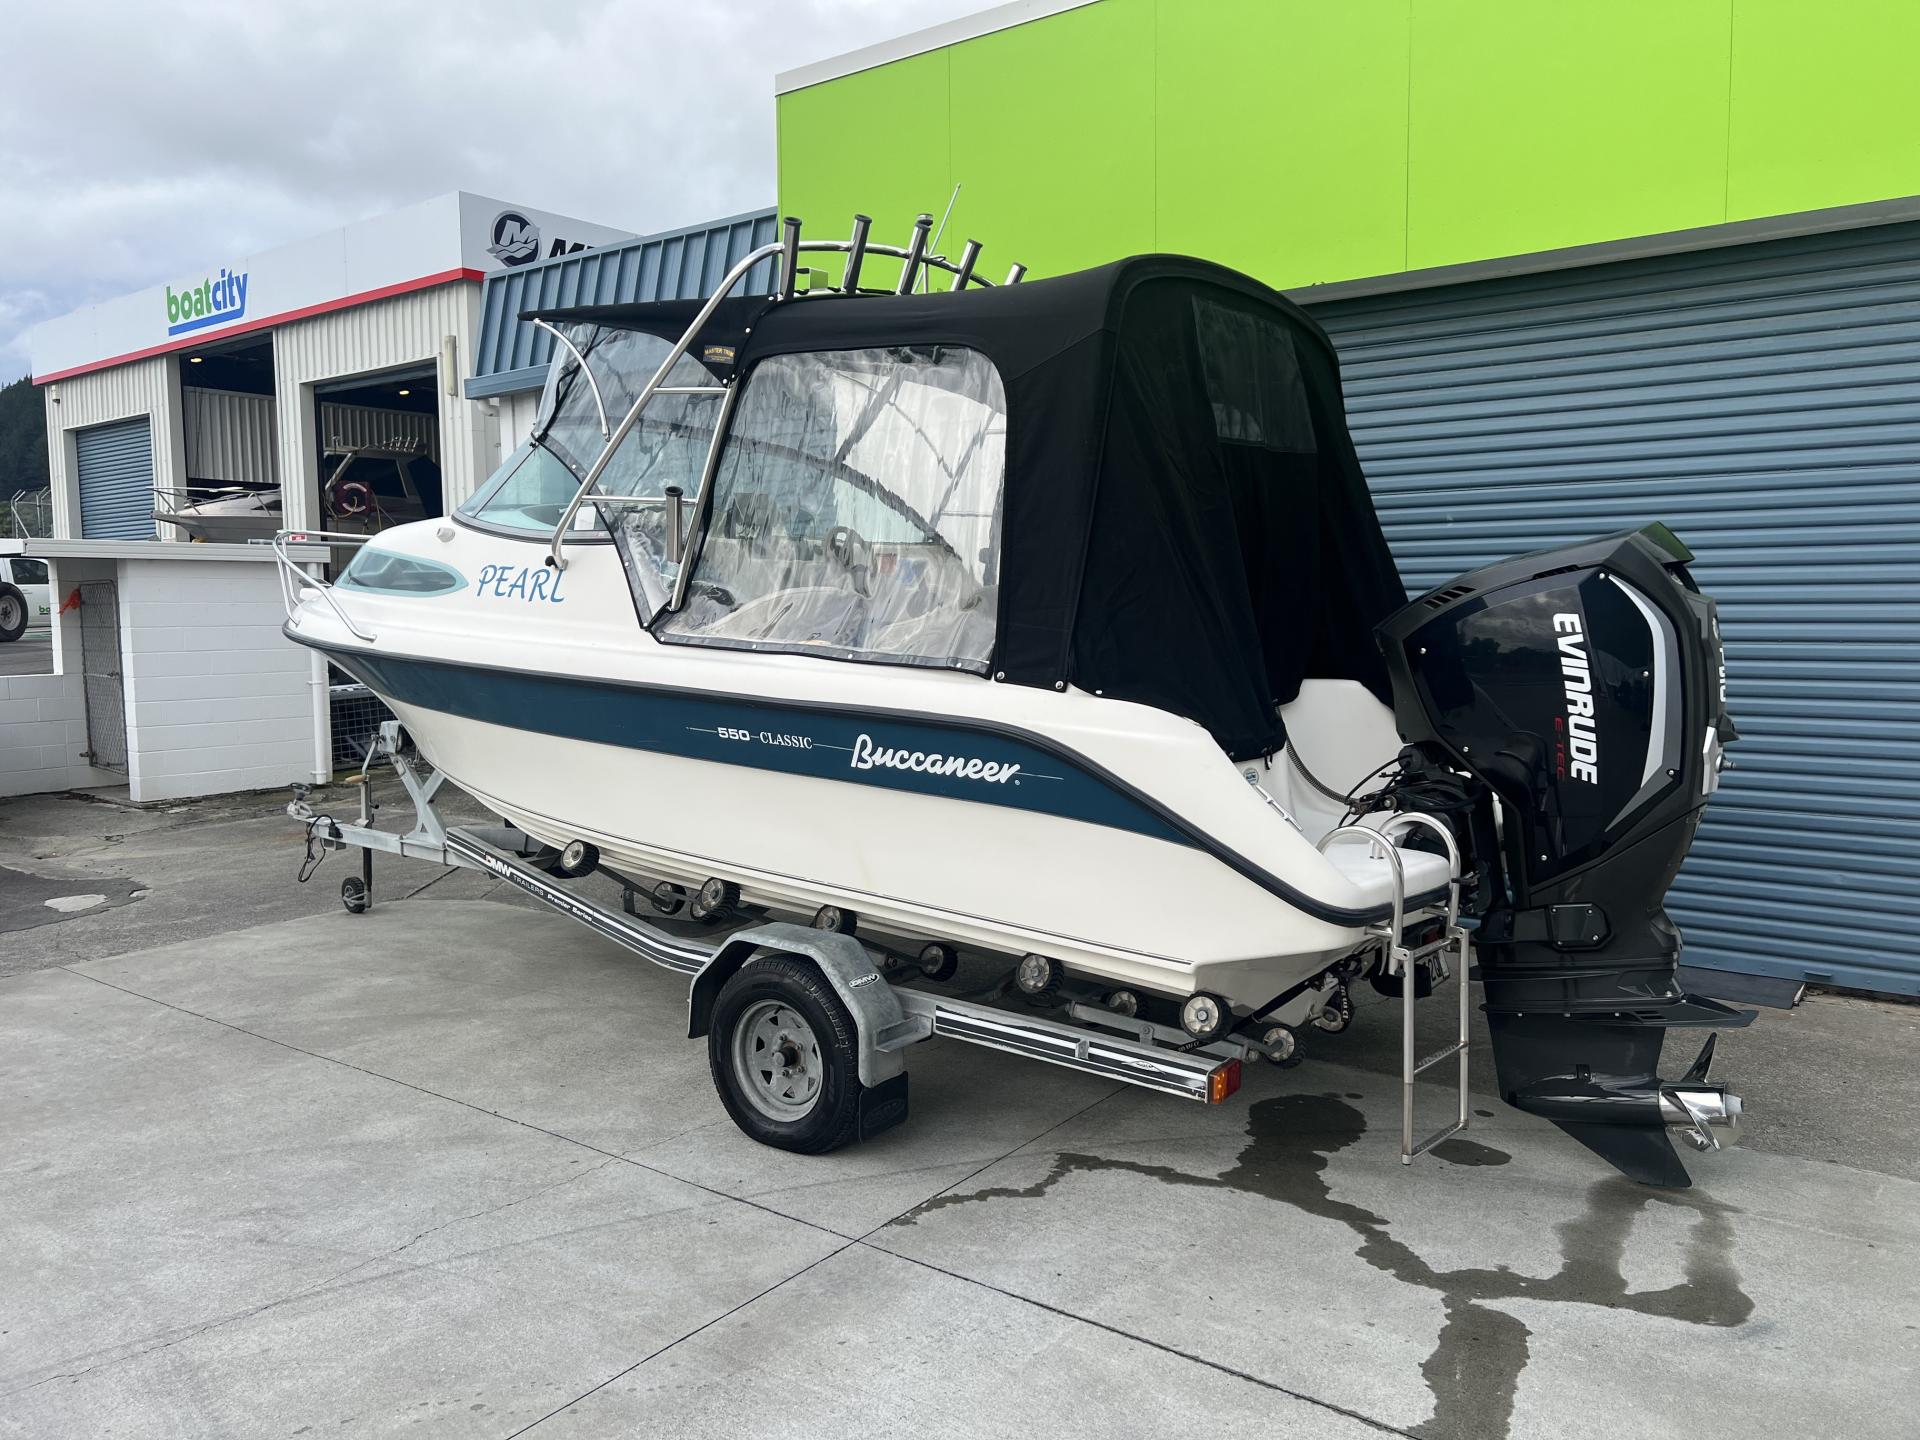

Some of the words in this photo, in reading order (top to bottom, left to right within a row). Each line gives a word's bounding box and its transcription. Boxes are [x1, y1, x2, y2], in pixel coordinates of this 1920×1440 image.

[166, 268, 248, 325] boatcity
[477, 564, 565, 603] PEARL
[1553, 613, 1598, 785] EVINRUDE
[717, 727, 750, 741] 550
[759, 731, 813, 750] CLASSIC
[851, 733, 1020, 784] Buccaneer
[1555, 717, 1565, 781] E-TEC
[513, 875, 544, 896] TRAILERS
[572, 907, 593, 922] Series
